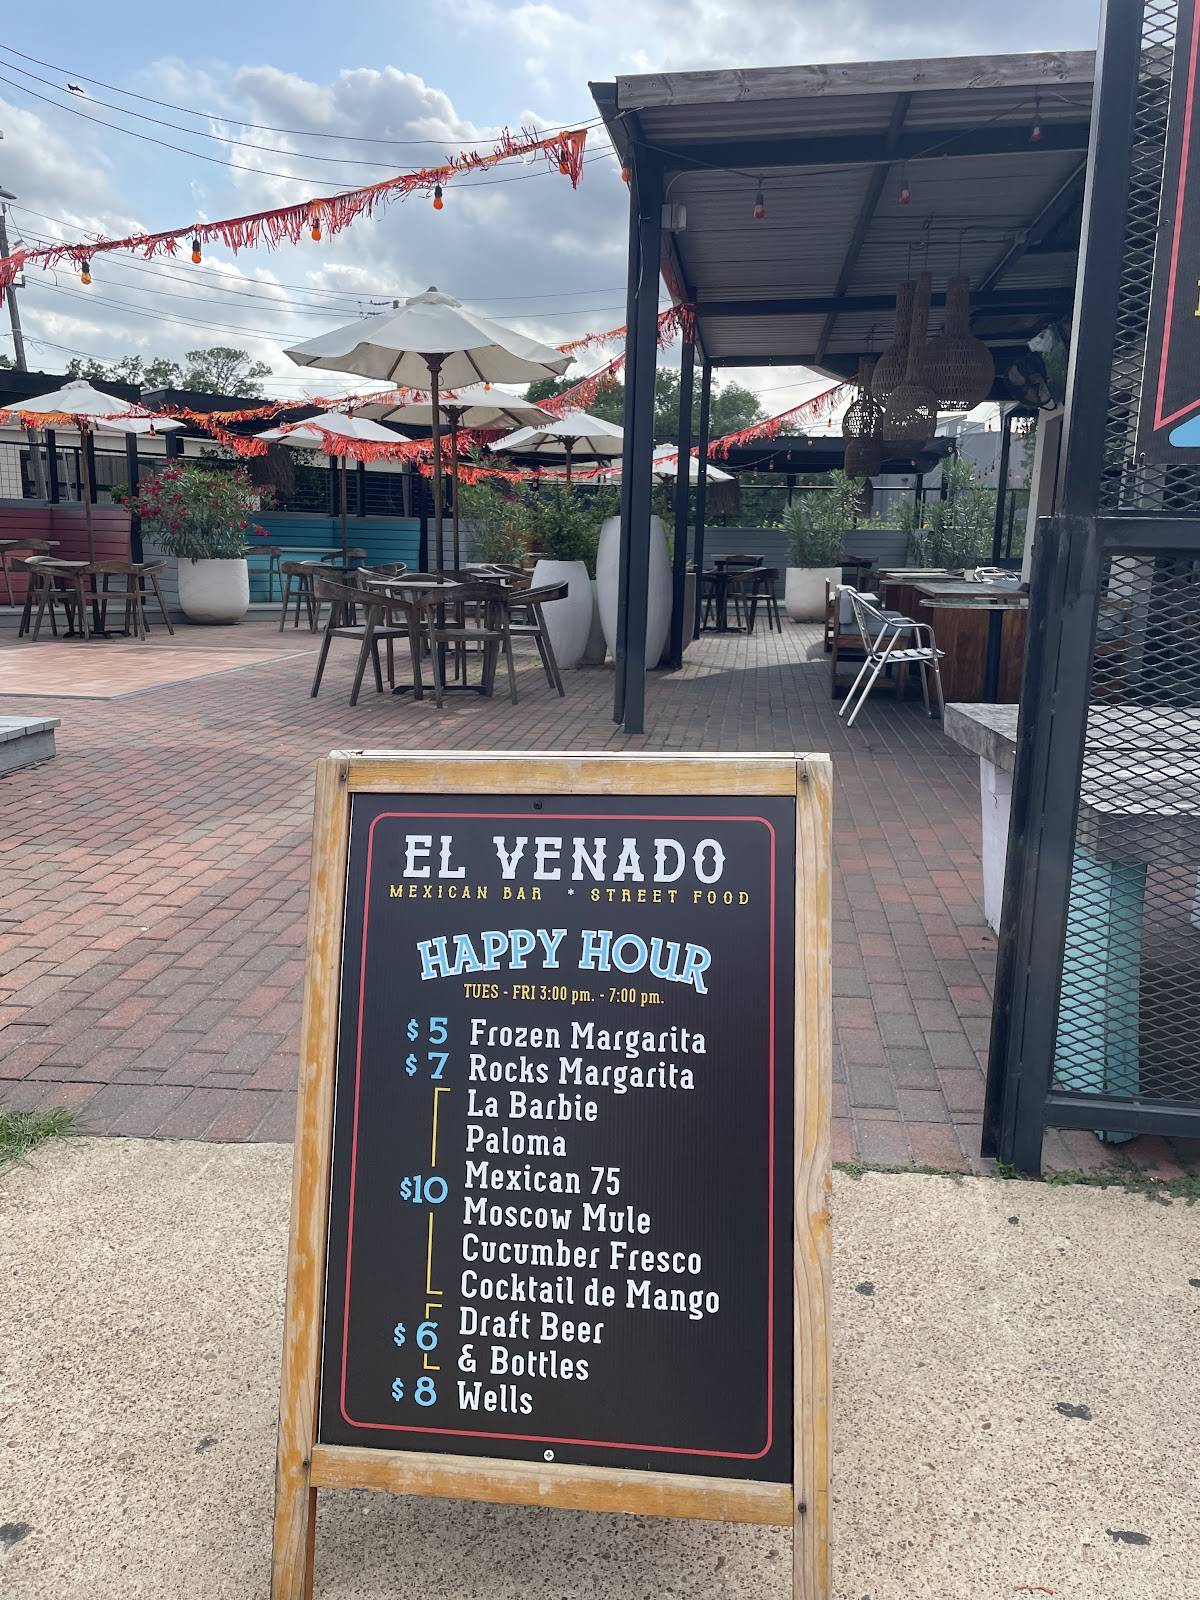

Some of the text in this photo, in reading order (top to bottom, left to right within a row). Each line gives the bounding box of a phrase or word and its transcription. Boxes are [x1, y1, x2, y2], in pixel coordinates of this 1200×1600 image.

[403, 835, 726, 884] EL VENADO
[390, 885, 487, 899] MEXICAN
[503, 887, 541, 900] BAR
[591, 888, 677, 903] STREET
[694, 891, 748, 904] FOOD
[417, 929, 711, 994] HAPPY HOUR
[464, 984, 498, 998] TUES
[513, 985, 535, 999] FRI
[540, 986, 566, 1000] 3:00
[572, 991, 594, 1004] pm.
[610, 988, 635, 1003] 7:00
[641, 993, 664, 1007] pm.
[470, 1019, 706, 1058] Frozen Margarita
[469, 1054, 694, 1094] Rocks Margarita
[468, 1089, 597, 1121] La Barbie
[466, 1125, 566, 1156] Paloma
[400, 1175, 448, 1203] $10
[465, 1161, 620, 1195] Mexican 75
[463, 1197, 650, 1234] Moscow Mule
[463, 1233, 701, 1274] Cucumber Fresco
[462, 1270, 719, 1320] Cocktail de Mango
[460, 1306, 604, 1344] Draft Beer
[458, 1344, 588, 1380] & Bottles
[457, 1381, 532, 1414] Wells
